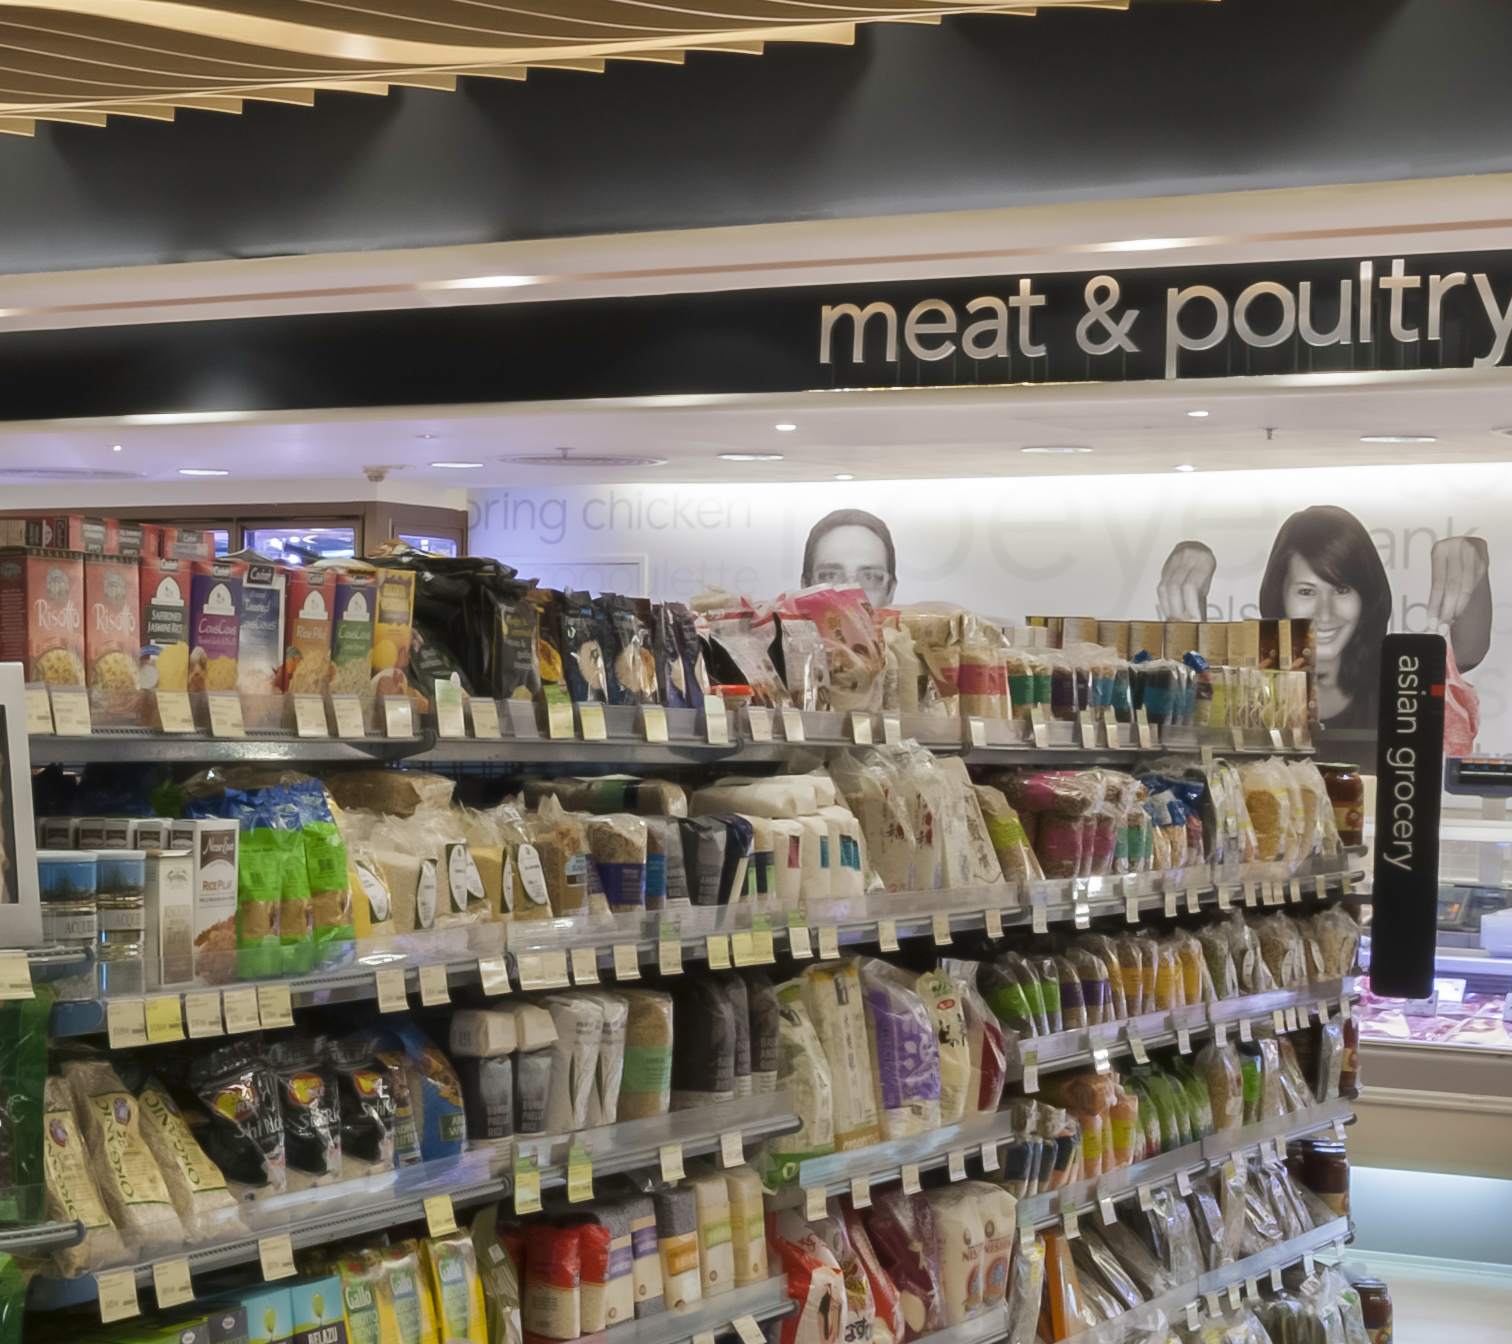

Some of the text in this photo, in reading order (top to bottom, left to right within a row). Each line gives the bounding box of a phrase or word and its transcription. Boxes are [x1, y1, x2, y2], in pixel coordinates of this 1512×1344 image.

[819, 278, 1046, 364] meat
[1075, 274, 1141, 355] &
[582, 490, 752, 531] chicken
[34, 598, 81, 637] Risotto
[92, 599, 137, 638] Risotto
[198, 617, 237, 635] CousCous
[1384, 656, 1426, 871] asian grocery
[202, 879, 217, 891] RICE
[390, 1272, 413, 1296] Gallo
[439, 1260, 463, 1282] Gallo
[345, 1278, 372, 1310] Gallo
